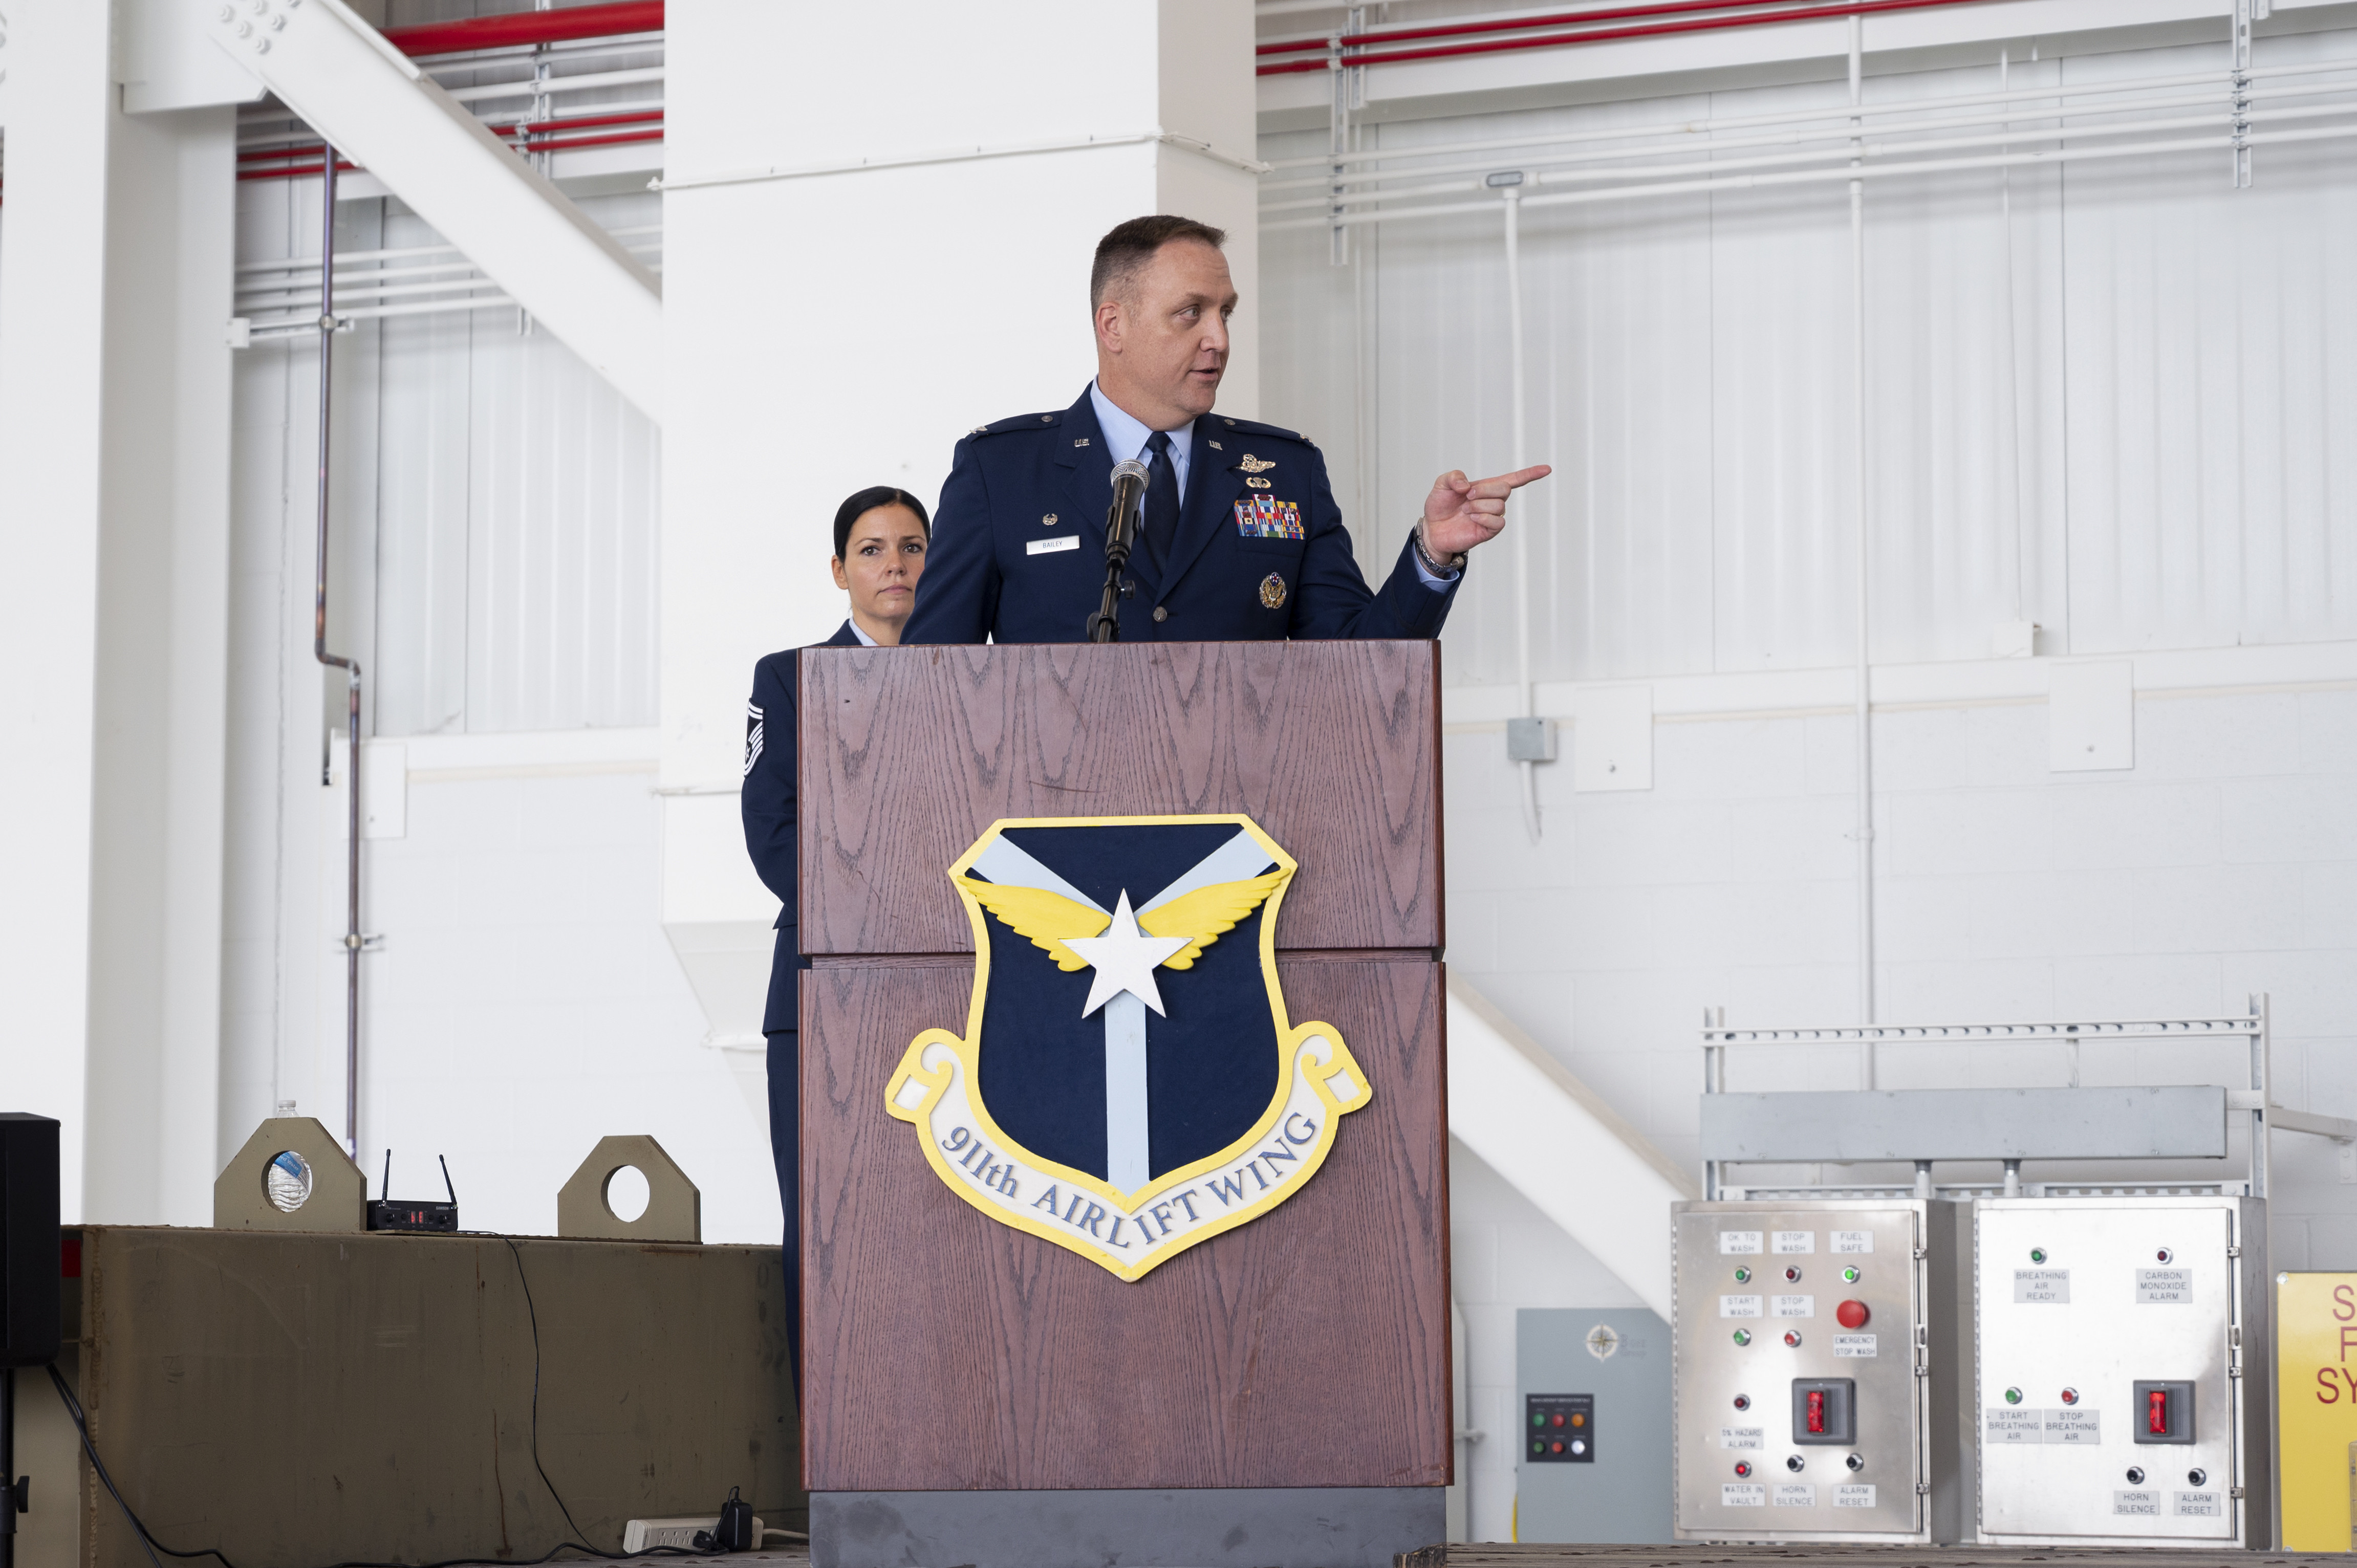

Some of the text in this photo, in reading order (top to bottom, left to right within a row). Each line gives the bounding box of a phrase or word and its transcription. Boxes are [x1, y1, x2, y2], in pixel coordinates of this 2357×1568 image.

[941, 1111, 1316, 1249] 911th AIRLIFT WING
[1728, 1233, 1756, 1241] OK TO
[2016, 1272, 2067, 1280] BREATHING
[1999, 1411, 2027, 1420] START
[2046, 1423, 2097, 1431] BREATHING
[2064, 1433, 2079, 1441] AIR
[2124, 1493, 2149, 1501] HORN
[2181, 1494, 2212, 1502] ALARM
[1776, 1497, 1813, 1506] SILENCE
[1840, 1498, 1869, 1506] RESET
[2117, 1505, 2156, 1513] SILENCE
[2181, 1506, 2212, 1514] RESET
